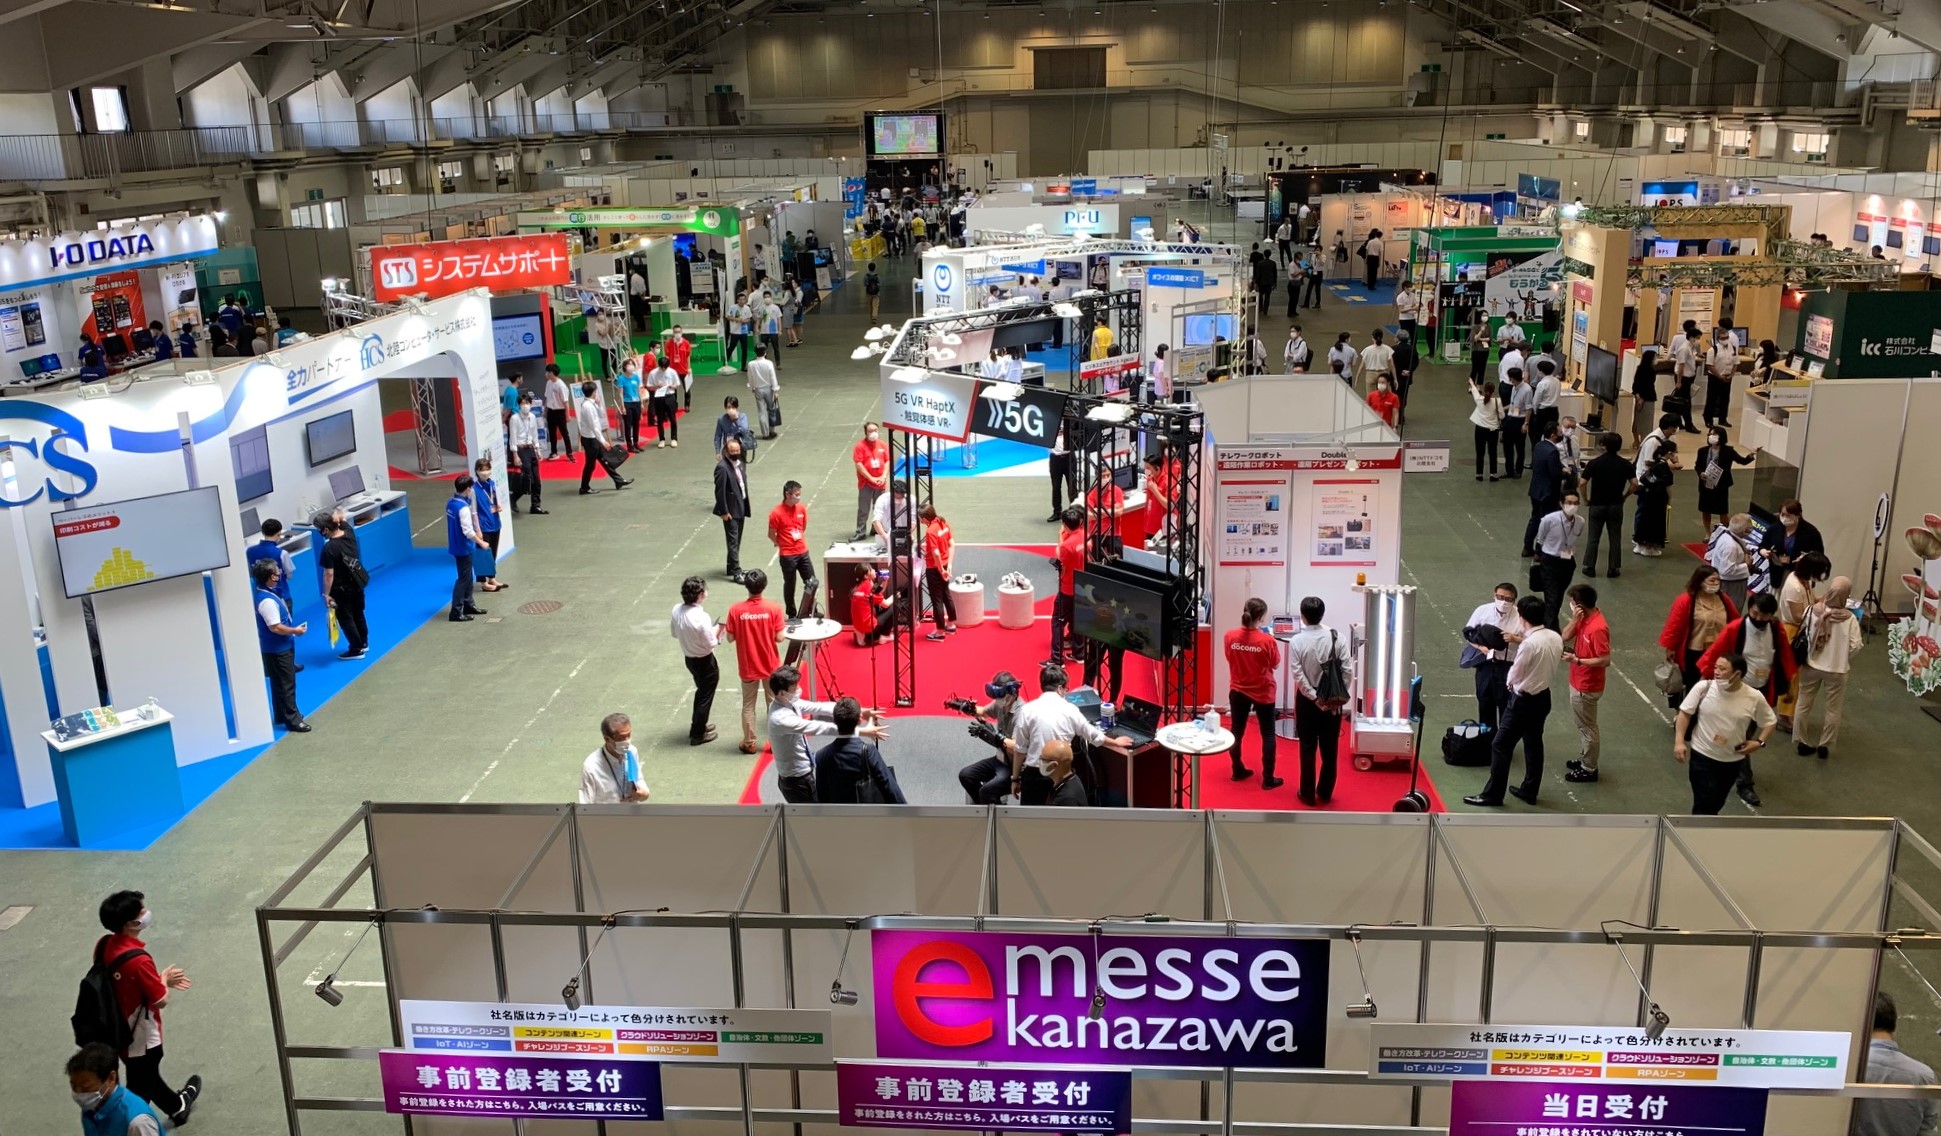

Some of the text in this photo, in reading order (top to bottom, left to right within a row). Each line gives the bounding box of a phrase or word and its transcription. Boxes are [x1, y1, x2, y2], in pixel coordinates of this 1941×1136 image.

[88, 234, 154, 263] DATA
[384, 262, 414, 284] STS
[423, 248, 566, 282] システムサポート
[1860, 338, 1882, 356] icc
[1886, 337, 1916, 345] 株式会社
[895, 391, 956, 415] 5G VR HaptX
[1004, 401, 1044, 437] 5G
[1231, 643, 1262, 653] docomo
[893, 940, 1300, 1047] e messe
[490, 1009, 735, 1025] 社名版はカテゴリーによって色分けされています。
[1006, 997, 1297, 1053] kanazawa
[525, 1029, 601, 1039] コンテンツ関連ゾーン
[620, 1032, 714, 1042] クラウドソリューションゾーン
[1470, 1031, 1741, 1048] 社名版はカテゴリーによって色分けされています。
[523, 1043, 606, 1053] チャレンジブースゾーン
[646, 1045, 689, 1055] RPAゾーン
[1505, 1052, 1590, 1062] コンテンツ関連ゾーン
[1611, 1054, 1715, 1065] クラウドソリューションゾーン
[416, 1065, 623, 1093] 事前登録者受付
[1500, 1066, 1593, 1076] チャレンジブースゾーン
[1637, 1069, 1686, 1078] RPAゾーン
[875, 1075, 1091, 1106] 事前登録者受付
[1542, 1093, 1668, 1120] 当日受付
